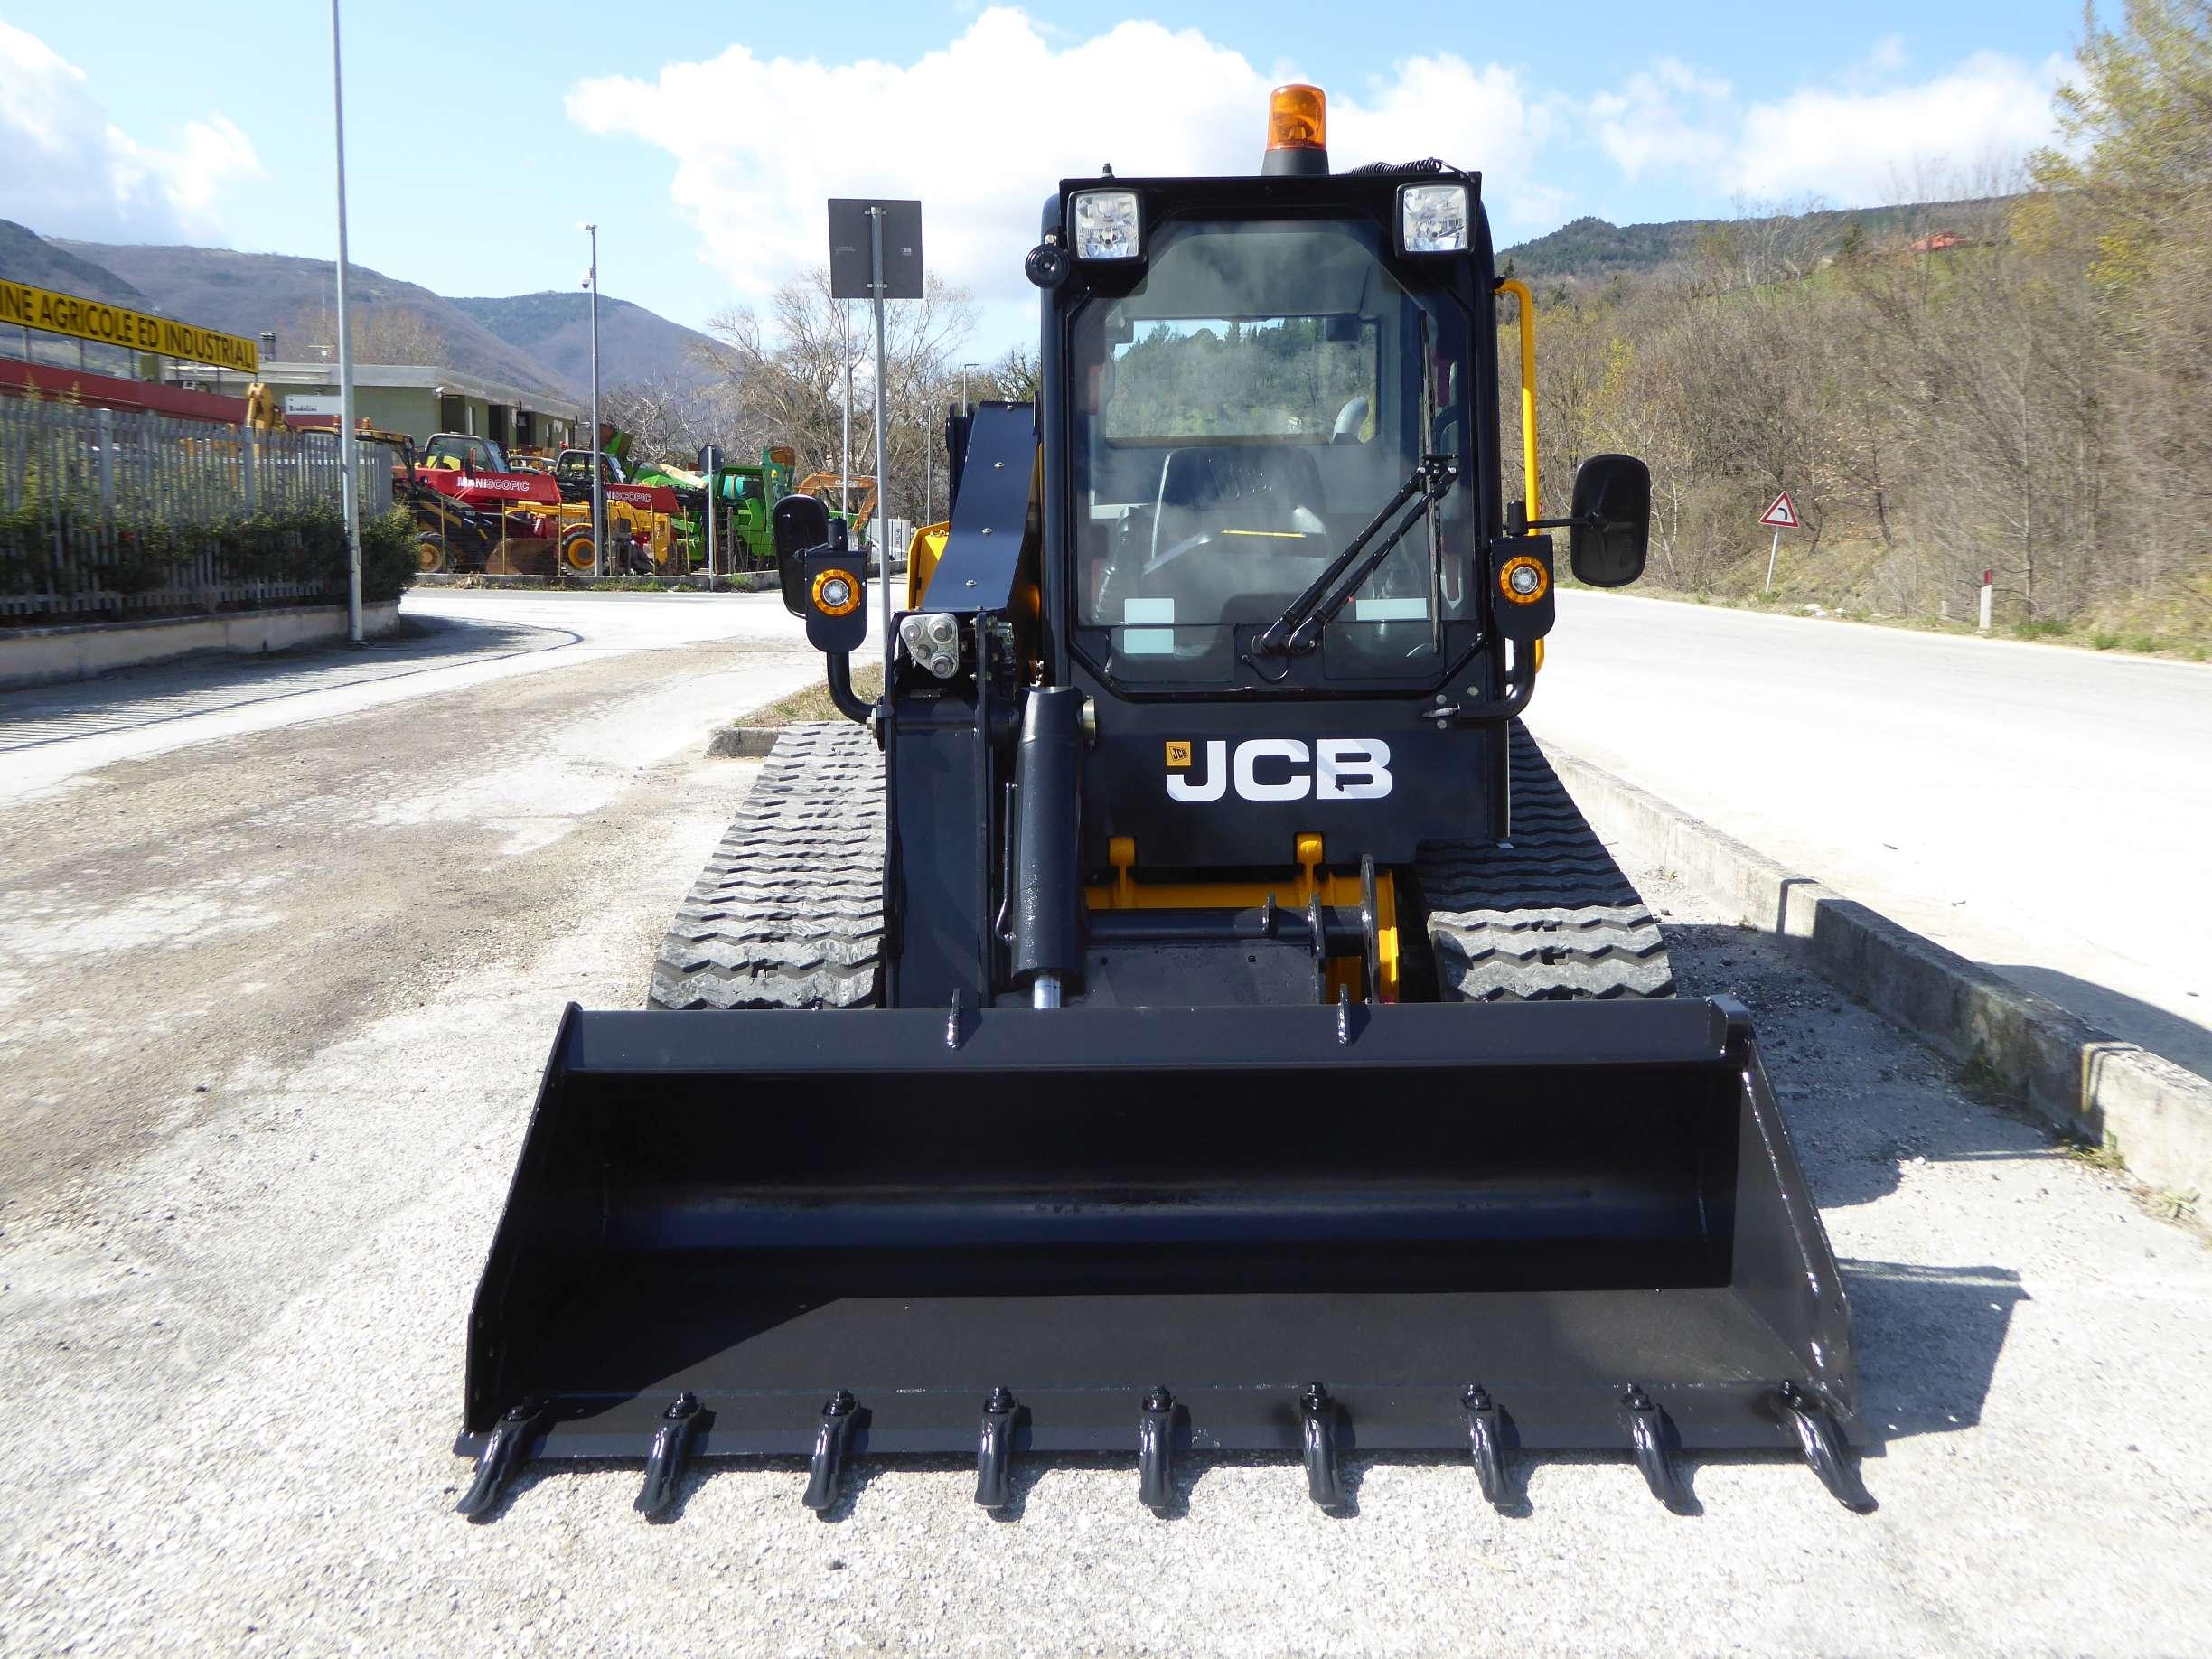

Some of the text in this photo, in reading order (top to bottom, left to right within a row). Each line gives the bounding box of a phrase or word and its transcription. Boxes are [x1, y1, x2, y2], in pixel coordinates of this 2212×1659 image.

[40, 295, 133, 343] AGRICOLE
[137, 317, 158, 348] ED
[164, 323, 256, 369] INDUSTRIALI
[1166, 738, 1392, 802] JCB
[1173, 748, 1186, 760] JCB
